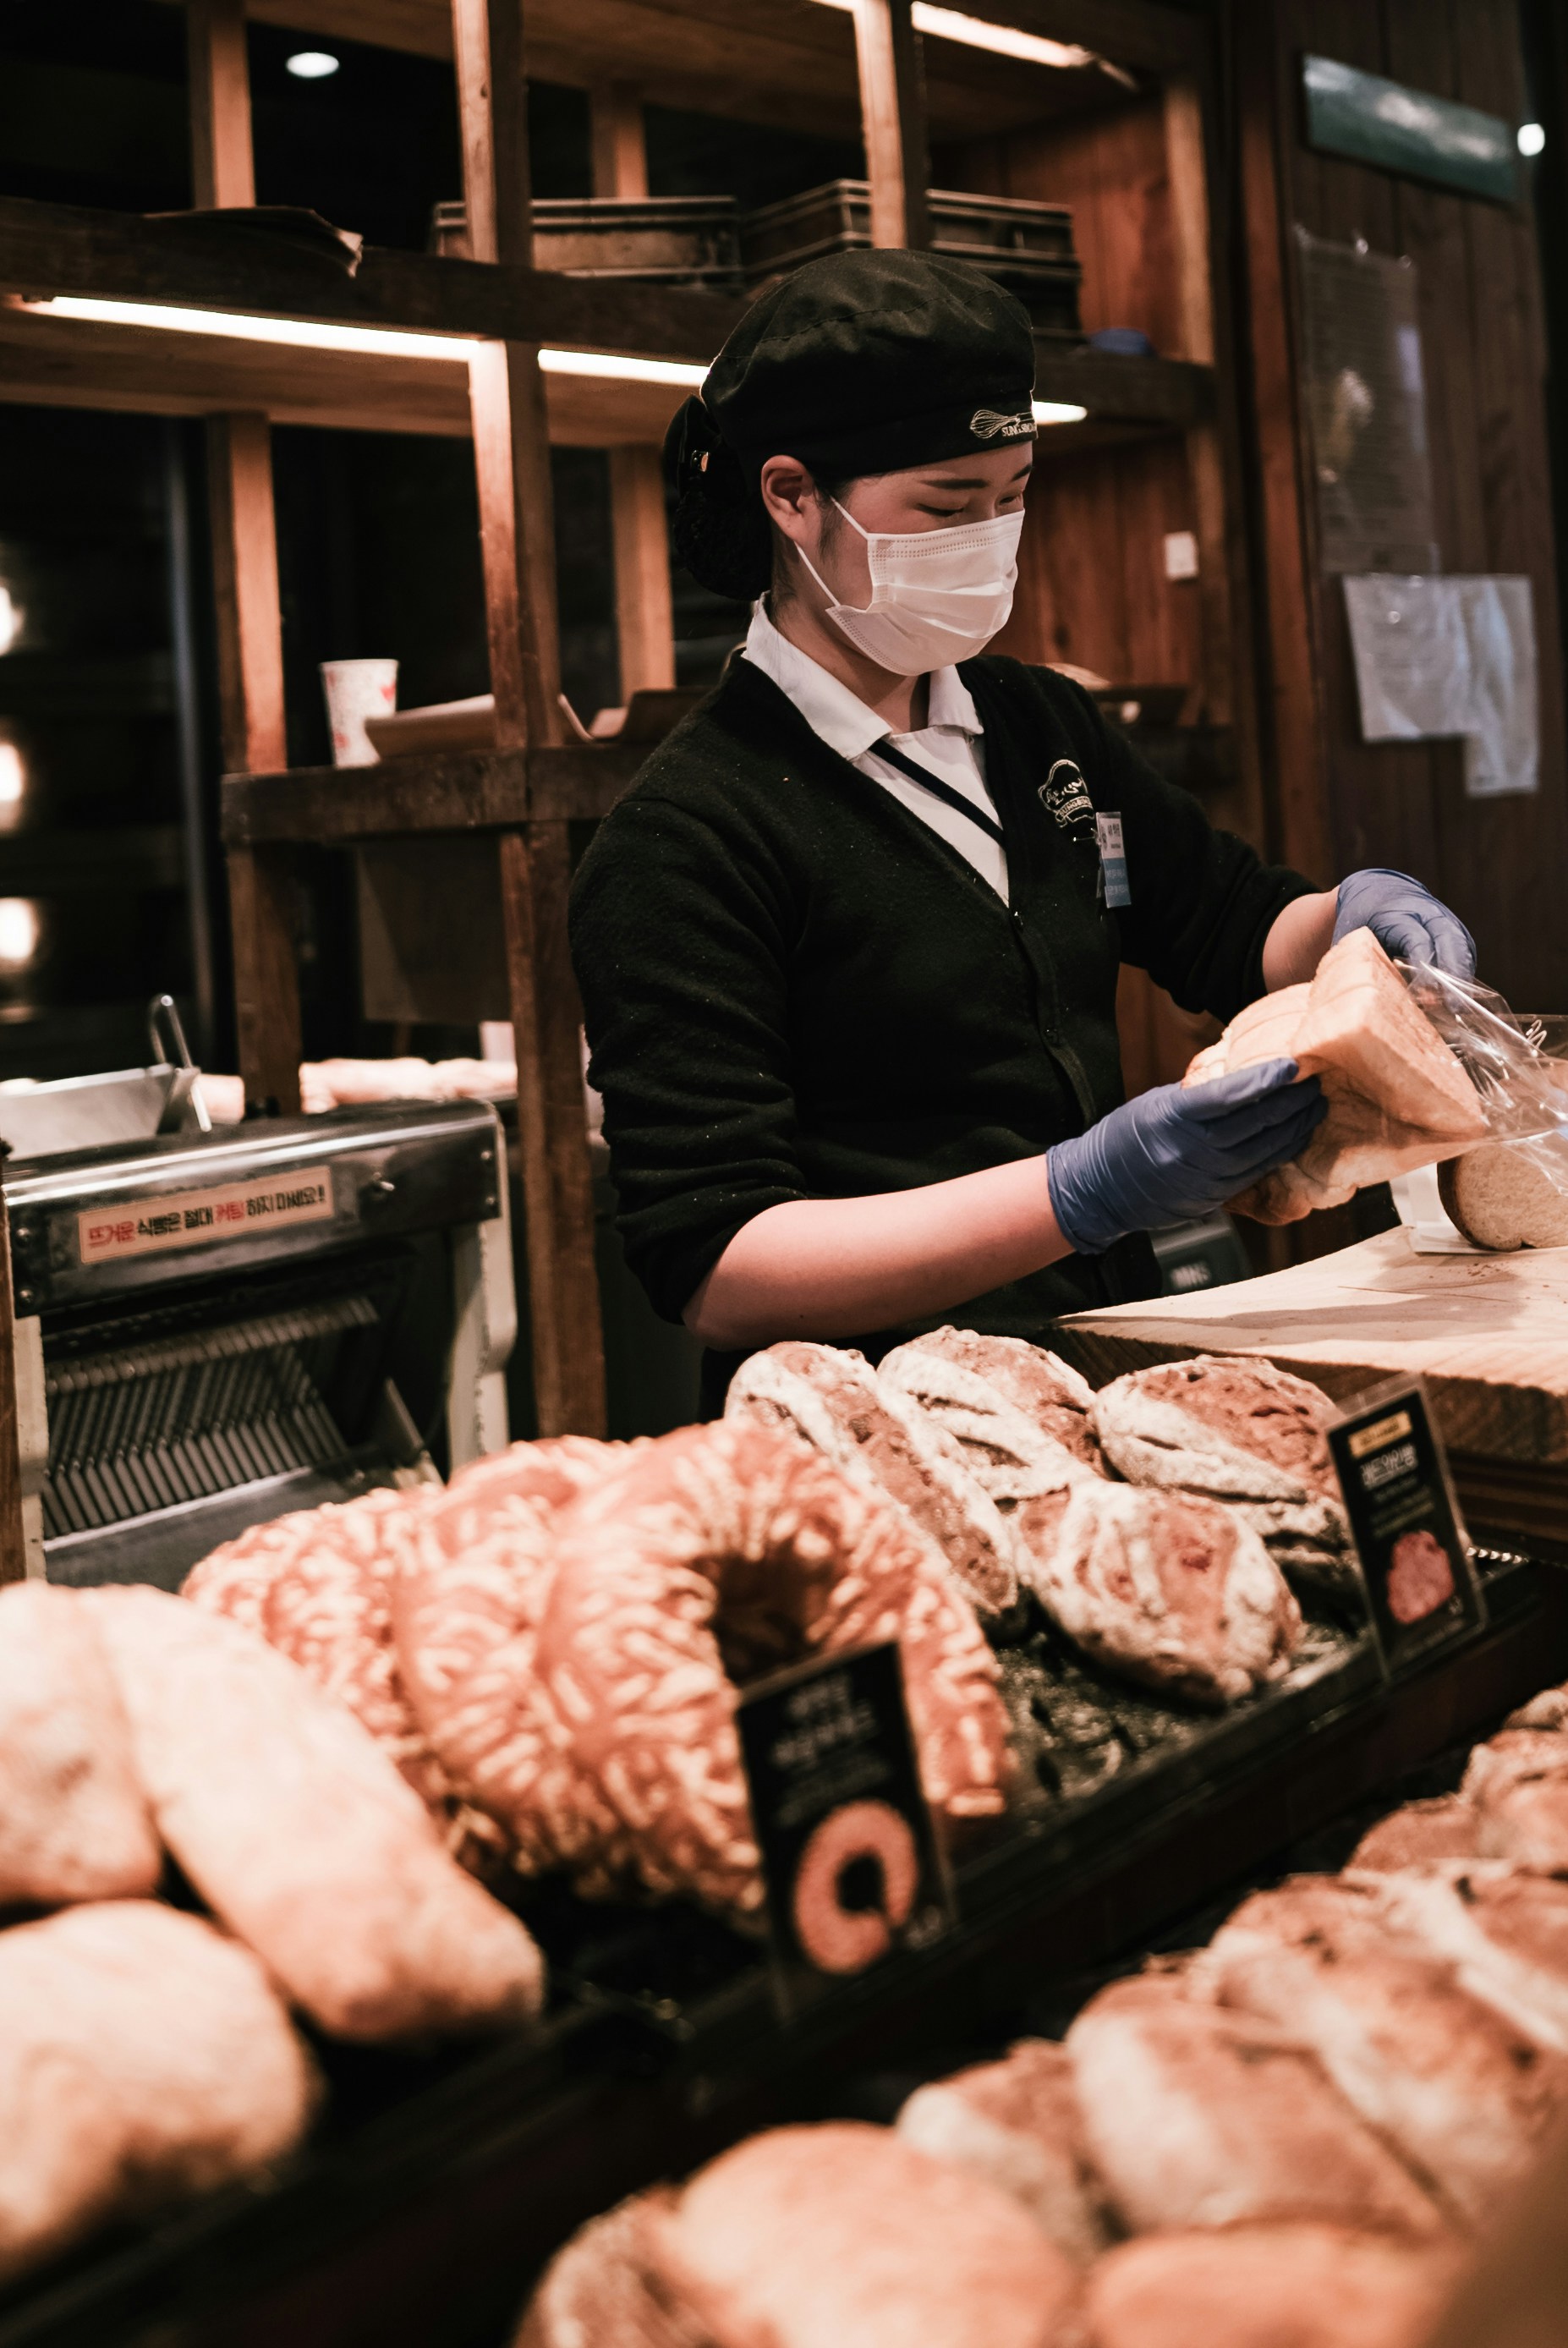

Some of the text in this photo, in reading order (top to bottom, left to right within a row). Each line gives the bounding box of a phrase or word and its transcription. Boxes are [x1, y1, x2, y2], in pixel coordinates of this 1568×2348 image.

[89, 1186, 325, 1248] 뜨거운 식빵은 절대 커팅 하지 마세요!
